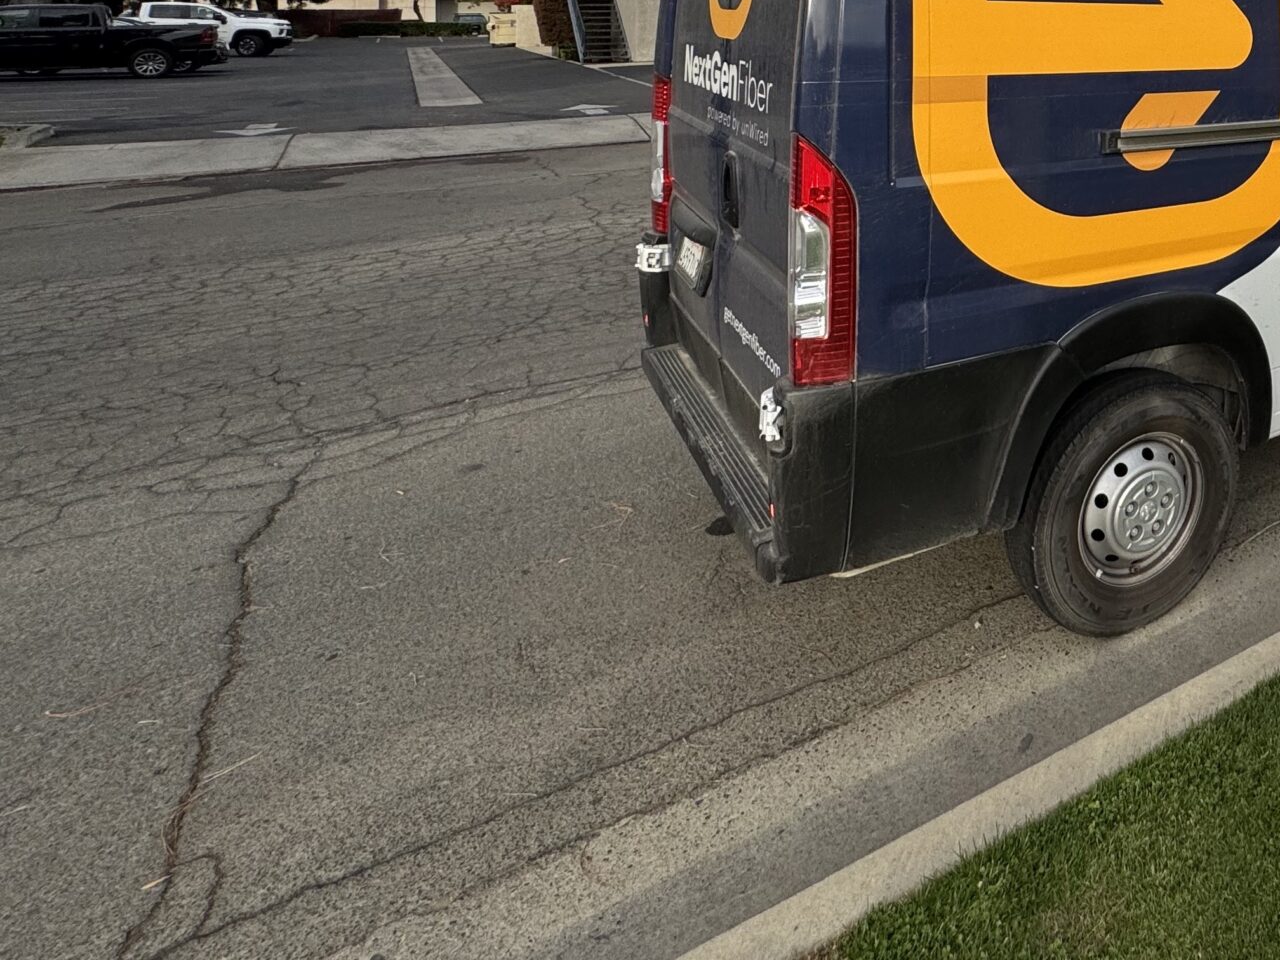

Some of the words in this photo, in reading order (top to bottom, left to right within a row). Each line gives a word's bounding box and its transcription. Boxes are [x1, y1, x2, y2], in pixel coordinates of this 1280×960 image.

[684, 44, 773, 114] NextGenFiber
[707, 106, 731, 127] powered
[732, 111, 740, 135] by
[741, 120, 768, 146] unWired
